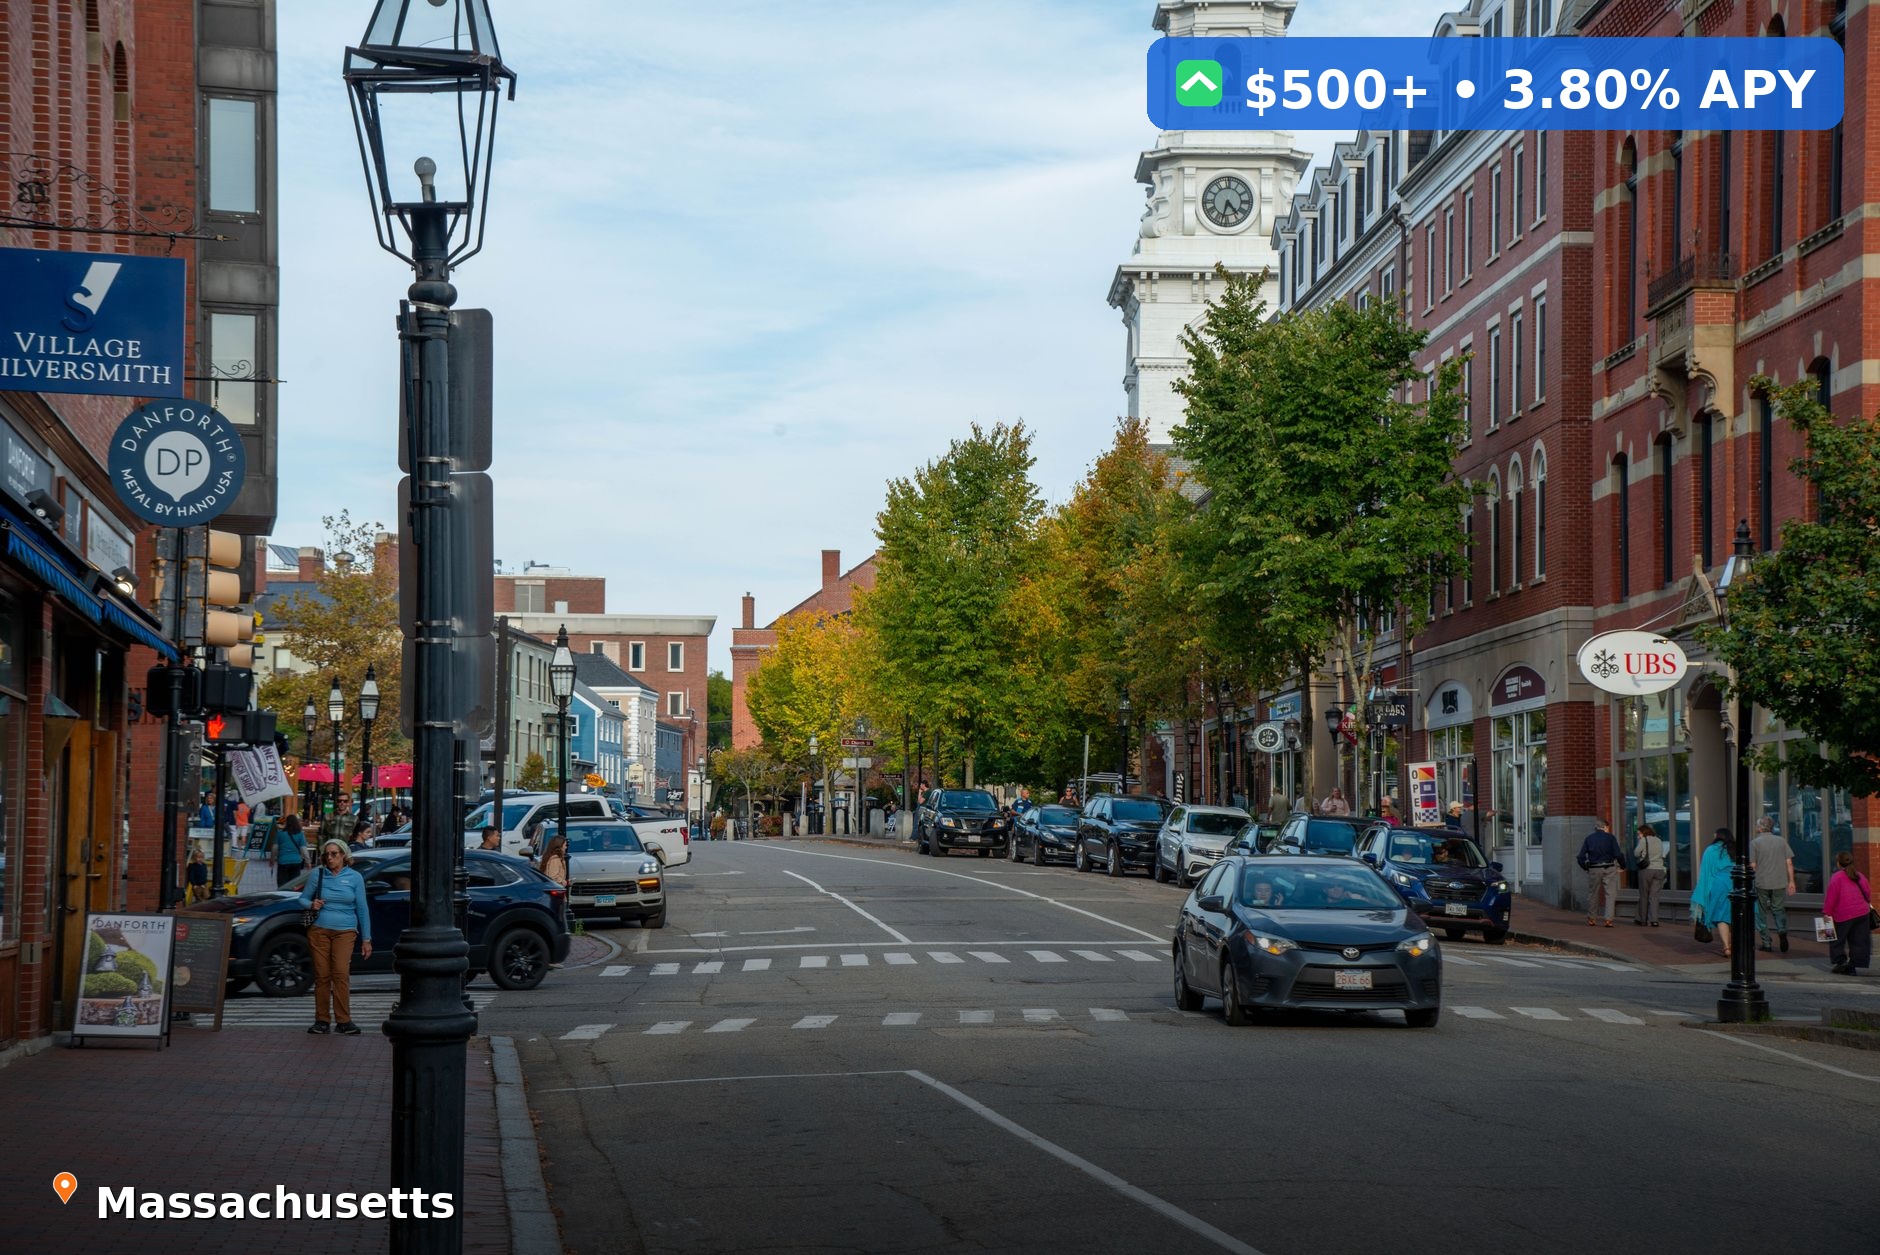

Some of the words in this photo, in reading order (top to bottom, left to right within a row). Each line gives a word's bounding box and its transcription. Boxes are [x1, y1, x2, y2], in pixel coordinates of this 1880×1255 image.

[14, 331, 142, 359] VILLAGE
[0, 357, 172, 385] ILVERSMITH
[157, 448, 203, 476] DP
[121, 468, 151, 509] METAL
[154, 503, 174, 516] BY
[177, 495, 217, 517] HAND
[214, 470, 234, 495] USA
[1624, 653, 1677, 675] UBS
[241, 774, 255, 792] SHOP
[1411, 769, 1422, 822] OPEN
[96, 920, 166, 930] DANFORTH
